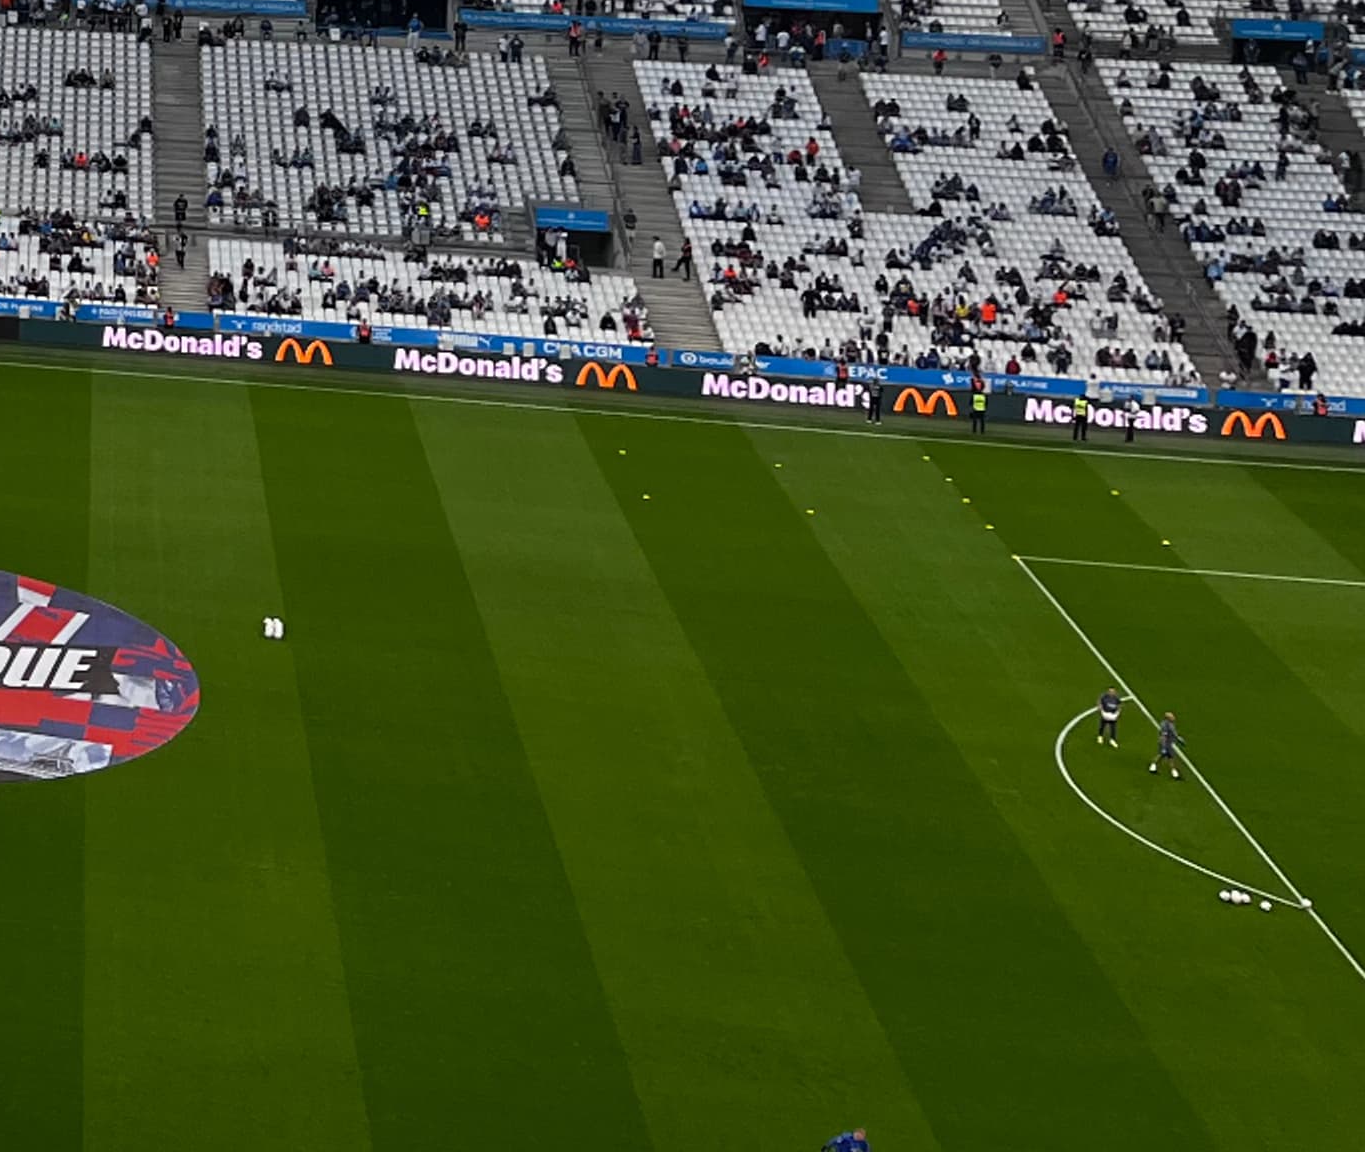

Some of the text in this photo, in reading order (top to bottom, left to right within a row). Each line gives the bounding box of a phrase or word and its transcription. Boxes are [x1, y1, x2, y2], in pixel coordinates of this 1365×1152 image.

[102, 325, 262, 360] McDonald's
[583, 345, 622, 359] CGM
[393, 347, 564, 384] McDonald's
[847, 366, 888, 380] EPAC
